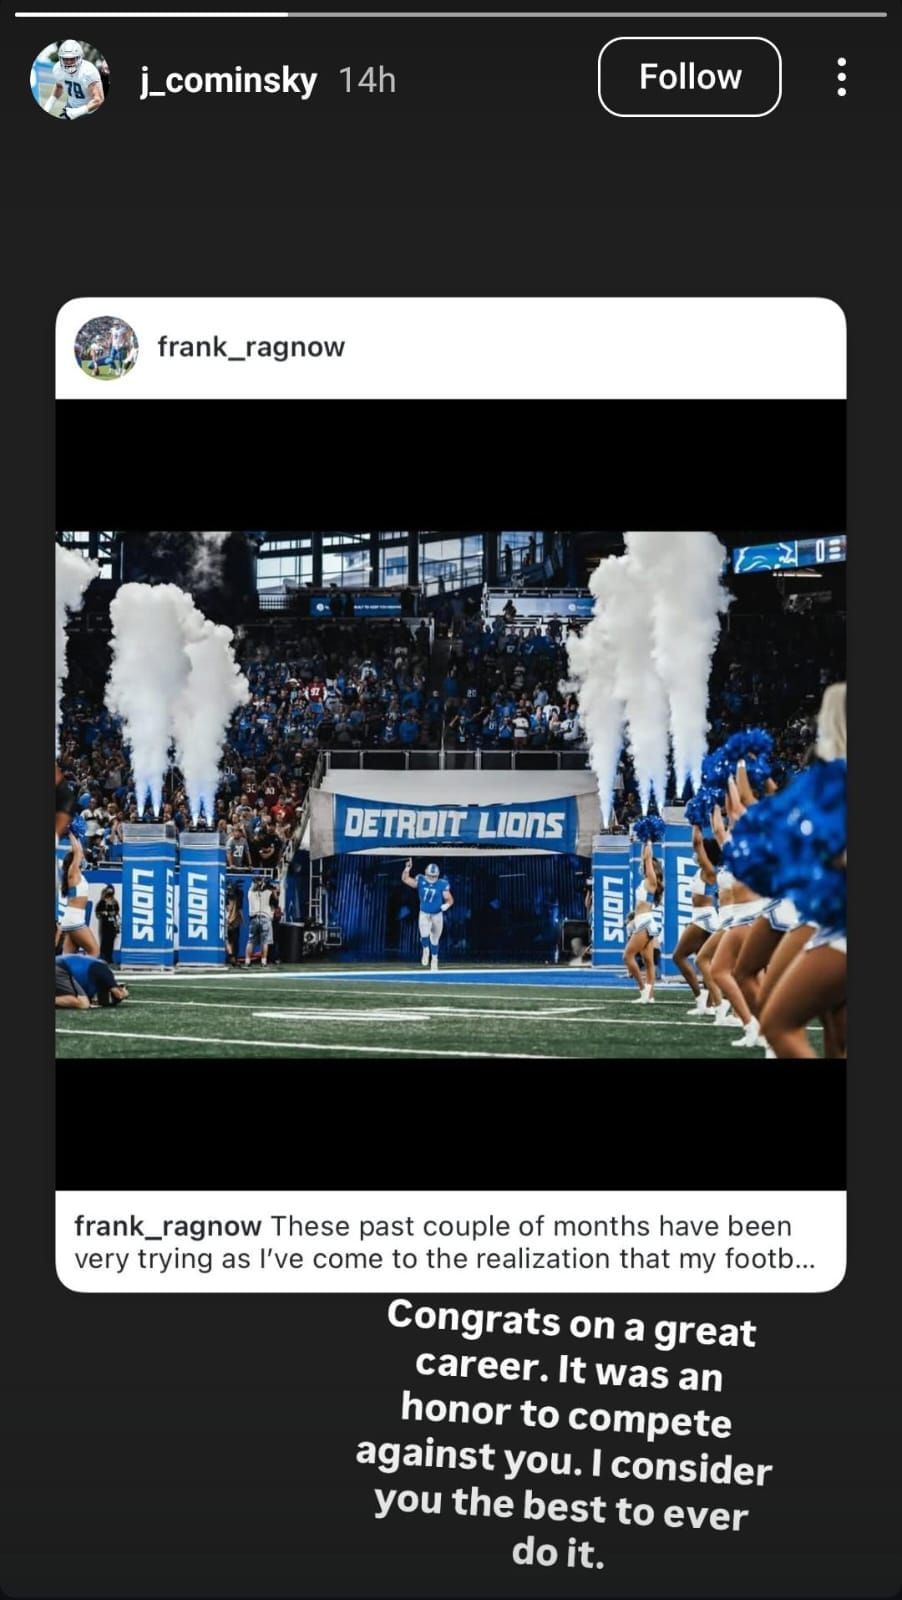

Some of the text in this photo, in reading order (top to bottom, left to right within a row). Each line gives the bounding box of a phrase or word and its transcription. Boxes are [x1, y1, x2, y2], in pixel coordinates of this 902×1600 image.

[64, 80, 85, 99] 79
[344, 807, 566, 839] DETROIT LIONS
[131, 868, 154, 942] LIONS
[187, 872, 208, 940] LIONS
[423, 887, 436, 903] 77
[603, 876, 624, 943] LIONS
